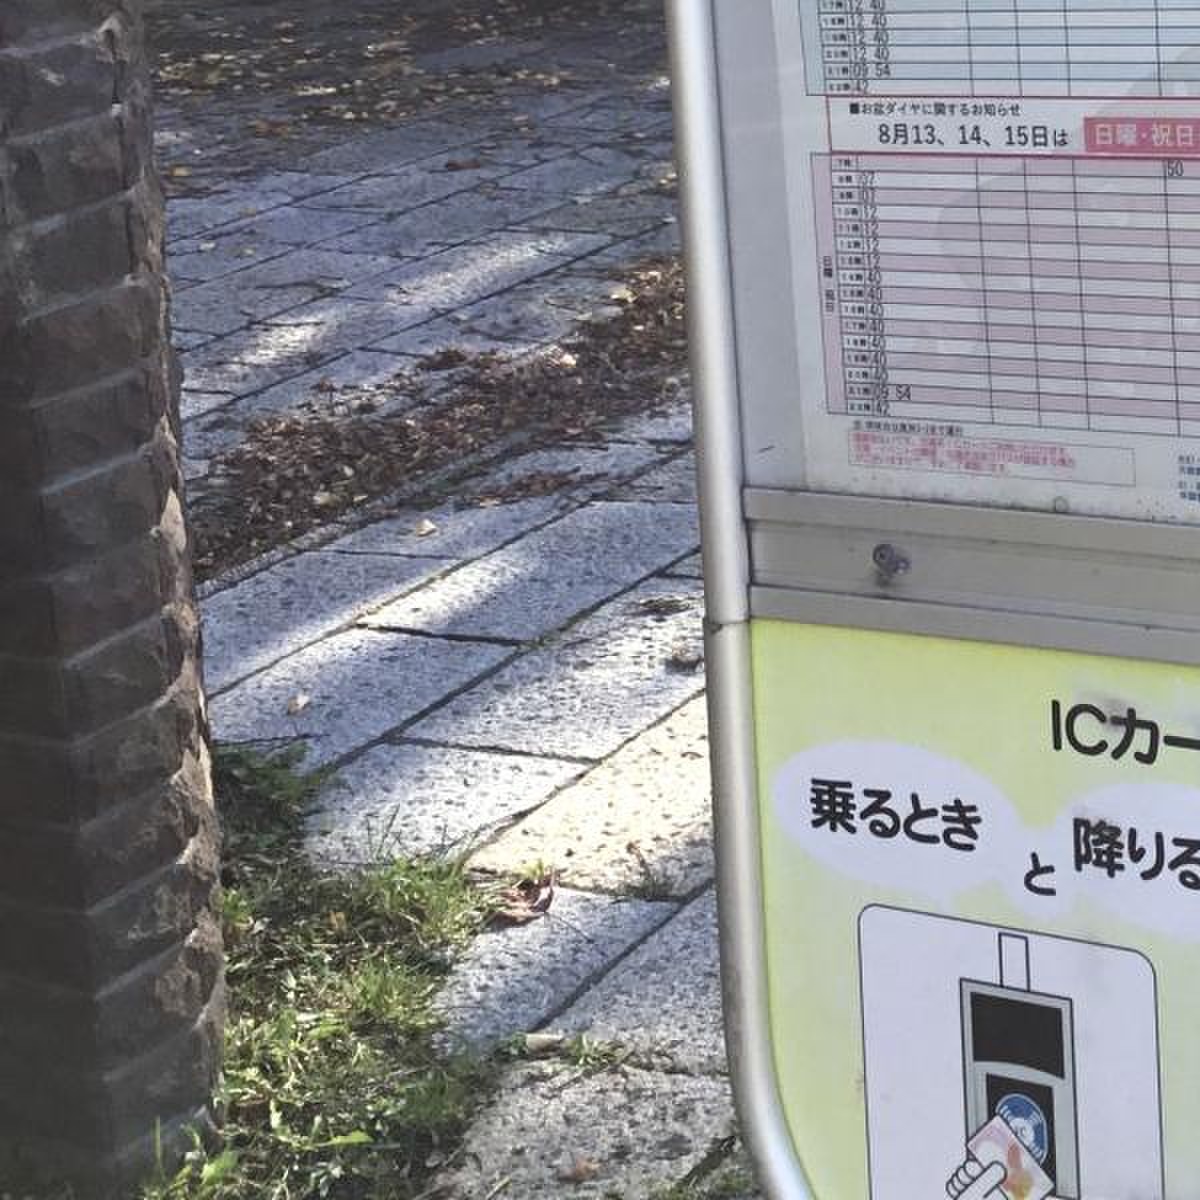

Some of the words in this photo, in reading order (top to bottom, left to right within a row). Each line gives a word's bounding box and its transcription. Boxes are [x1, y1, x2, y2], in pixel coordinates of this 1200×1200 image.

[862, 102, 1021, 117] お盆ダイヤに関するお知らせ
[878, 123, 1069, 147] 8月13、14、15日は
[810, 778, 982, 852] 乗るとき
[1024, 852, 1057, 896] と
